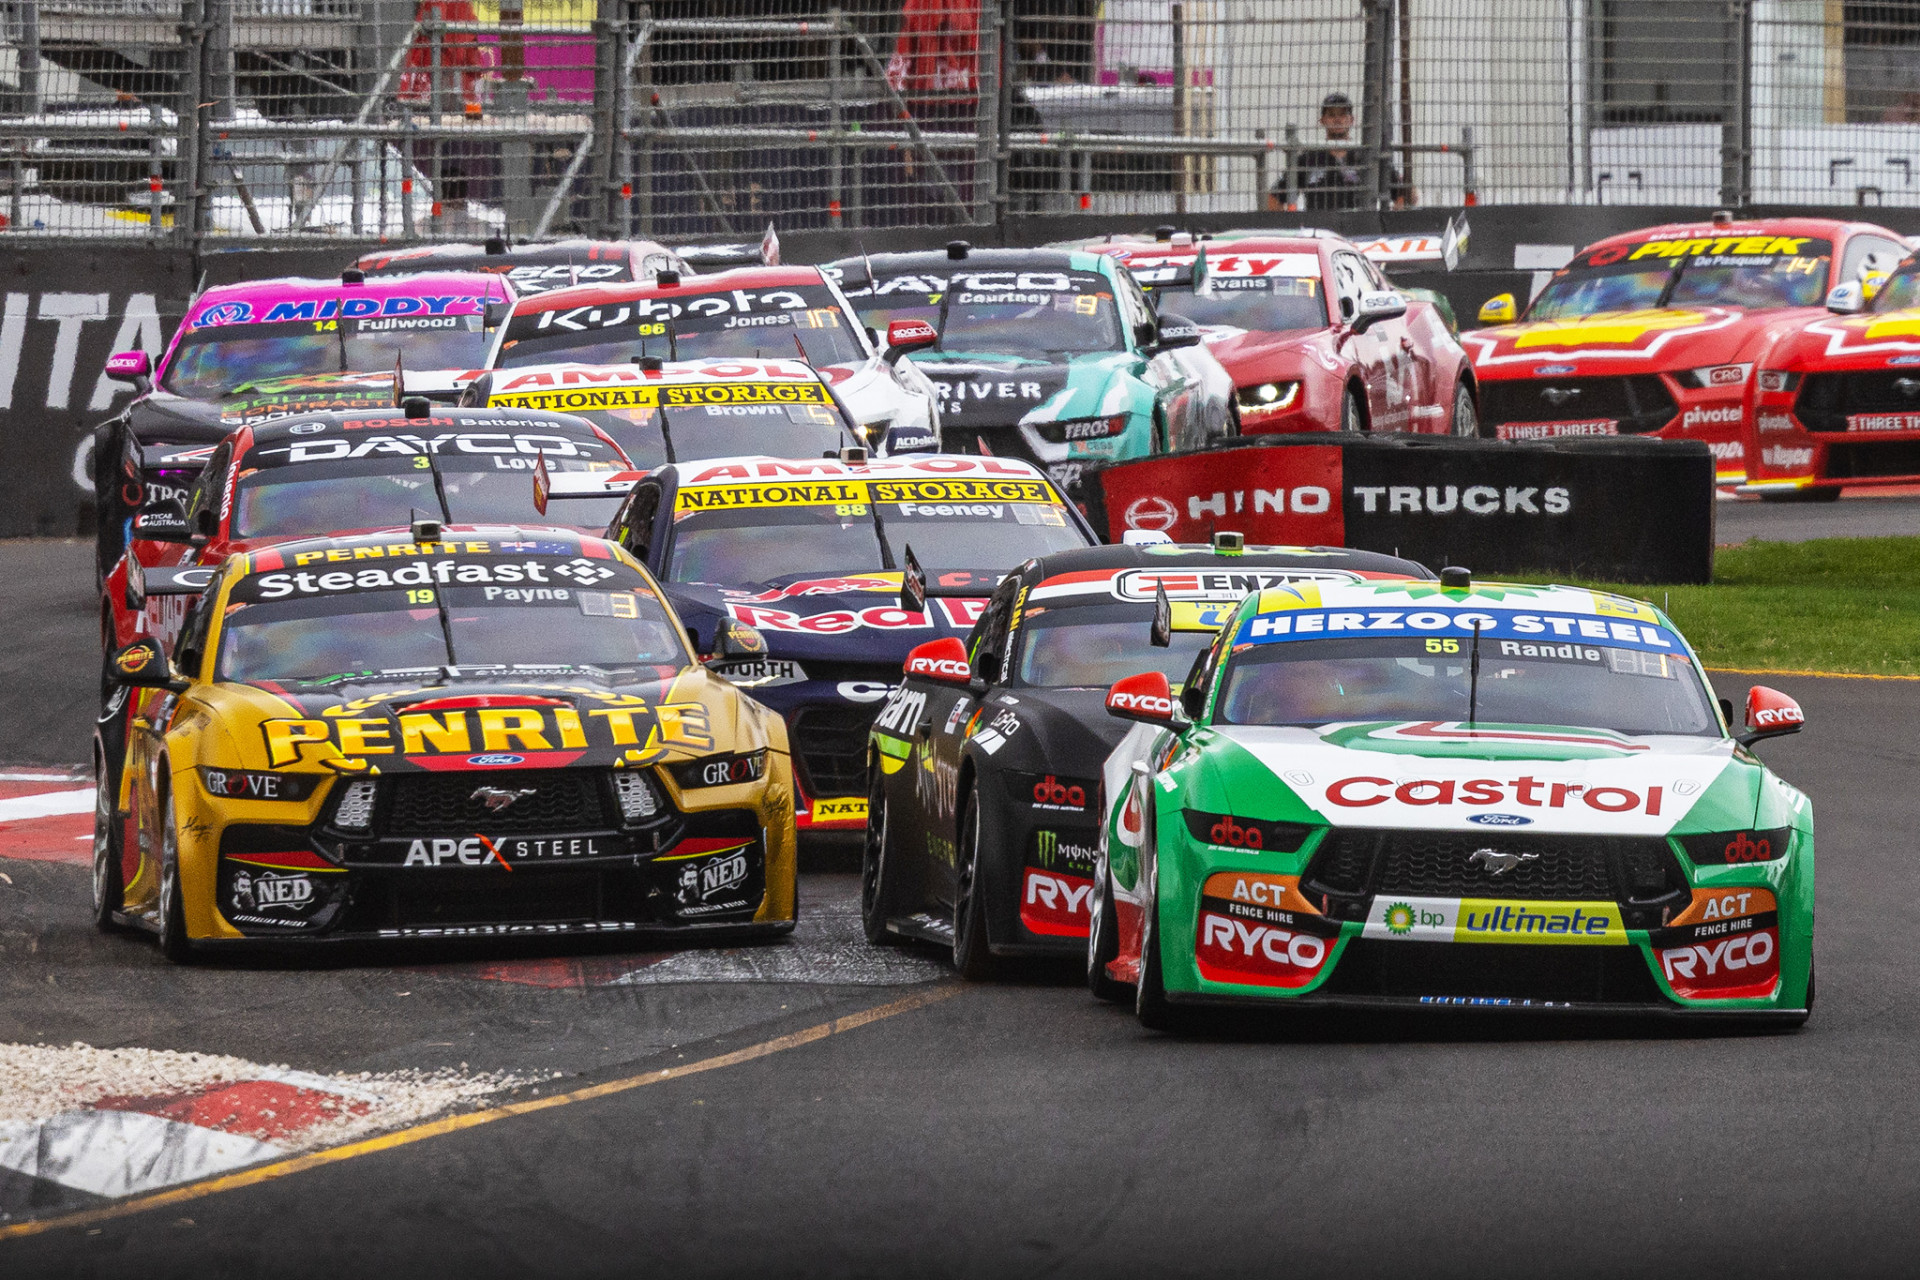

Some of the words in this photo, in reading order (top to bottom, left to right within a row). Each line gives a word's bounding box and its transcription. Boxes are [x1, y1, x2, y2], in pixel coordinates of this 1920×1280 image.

[1360, 239, 1442, 253] AIL
[1628, 236, 1812, 261] PIRTEK
[537, 289, 808, 331] Kubota
[959, 292, 1051, 306] Courtney
[313, 320, 339, 332] 14
[358, 317, 457, 332] Fullwood
[638, 323, 666, 336] 96
[724, 312, 791, 328] Jones
[0, 292, 200, 411] ITA
[492, 389, 651, 411] NATIONAL
[669, 383, 820, 405] STORAGE
[706, 403, 783, 417] Brown
[342, 417, 453, 431] BOSCH
[460, 418, 560, 429] Batteries
[289, 432, 578, 463] DAYCO
[413, 457, 431, 470] 3
[681, 485, 859, 508] NATIONAL
[876, 482, 1043, 502] STORAGE
[1188, 485, 1331, 520] HINO
[1353, 485, 1571, 514] TRUCKS
[834, 504, 868, 517] 88
[898, 502, 1005, 518] Feeney
[294, 541, 491, 566] PENRITE
[257, 560, 550, 598] Steadfast
[1202, 574, 1337, 592] ENZ
[407, 588, 435, 605] 19
[484, 587, 570, 603] Payne
[1250, 611, 1498, 638] HERZOG
[1511, 614, 1671, 648] STEEL
[1425, 638, 1460, 654] 55
[1500, 639, 1600, 662] Randle
[910, 657, 971, 676] RYCO
[1110, 692, 1172, 712] RYCO
[260, 702, 715, 770] PENRITE
[206, 771, 279, 799] GROVE
[1033, 774, 1086, 807] dba
[1325, 774, 1663, 817] Castrol
[1210, 815, 1263, 849] dba
[1479, 813, 1521, 826] Ford
[402, 832, 513, 872] APEX
[515, 837, 598, 858] STEEL
[1057, 842, 1101, 864] MONS
[1725, 832, 1771, 862] dba
[702, 854, 748, 892] NED
[257, 877, 312, 903] NED
[1231, 878, 1286, 907] ACT
[1229, 903, 1263, 919] FENCE
[1266, 910, 1294, 925] HIRE
[1702, 892, 1752, 920] ACT
[1420, 908, 1445, 929] bp
[1467, 905, 1610, 936] ultimate
[1694, 922, 1724, 938] FENCE
[1726, 917, 1753, 933] HIRE
[1203, 913, 1326, 970] RYCO
[1661, 931, 1774, 982] RYCO
